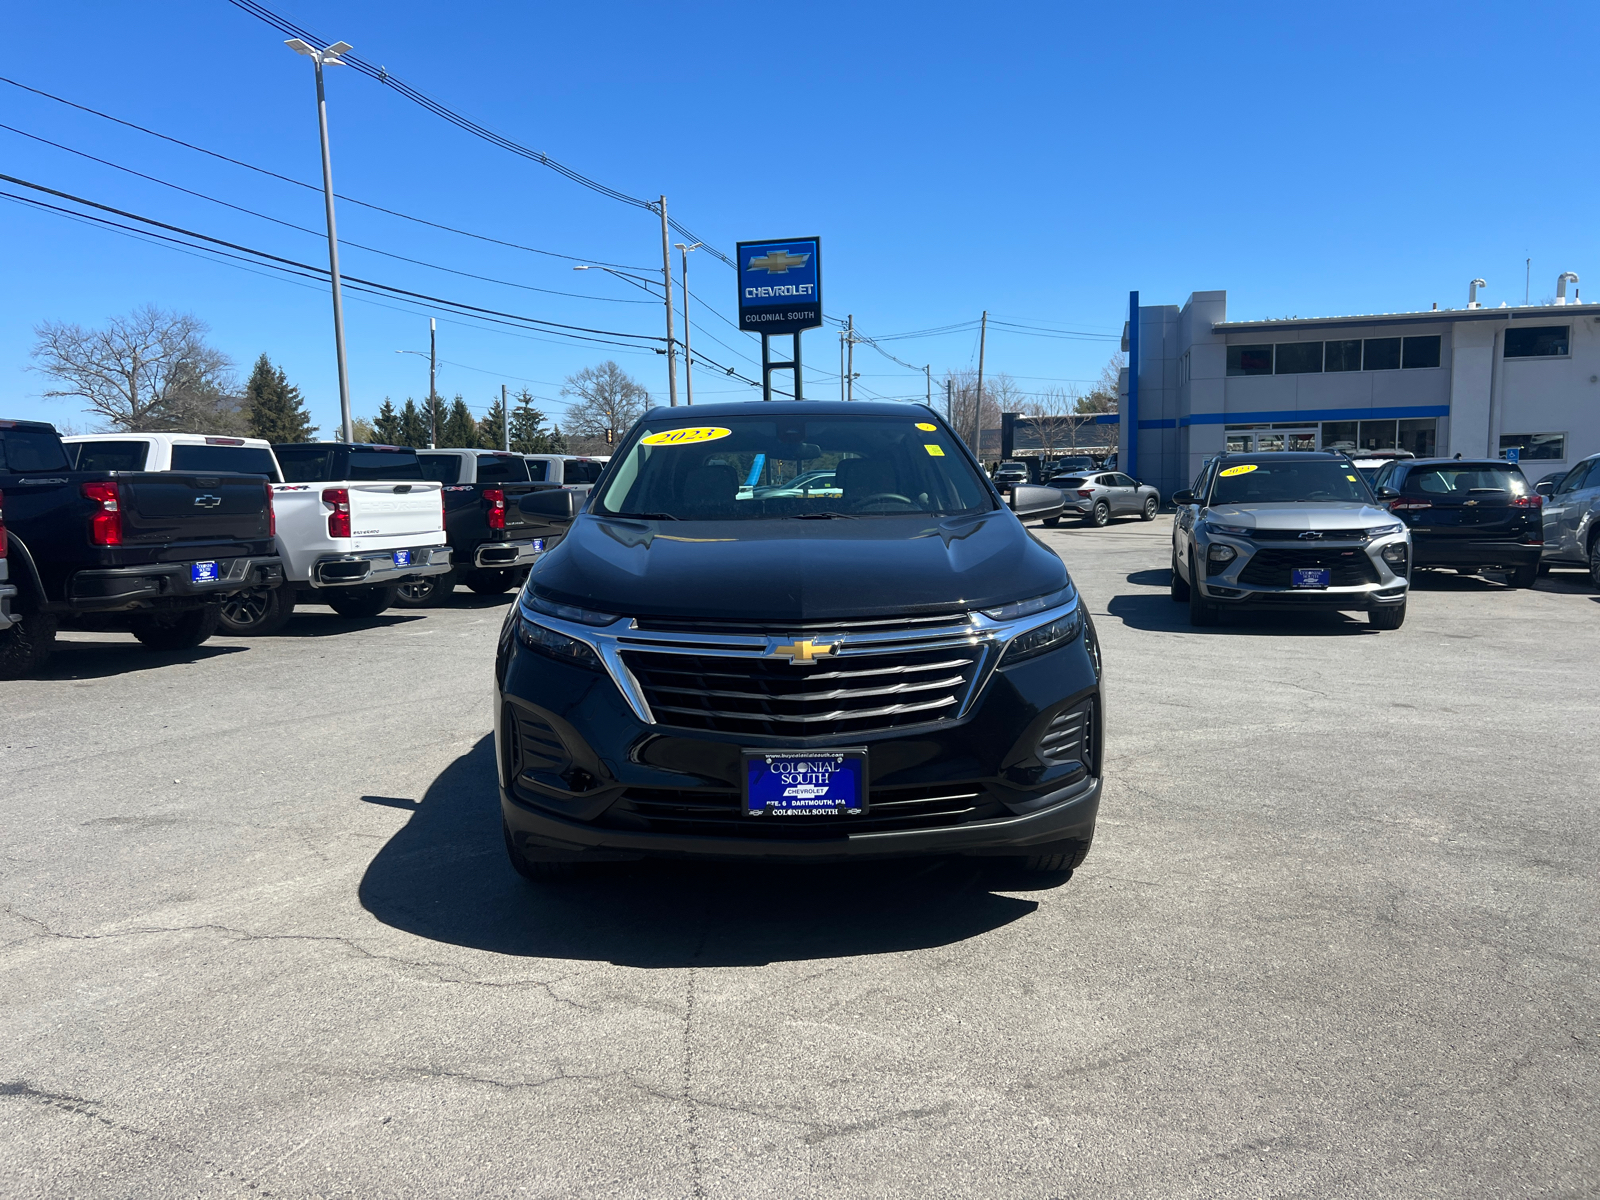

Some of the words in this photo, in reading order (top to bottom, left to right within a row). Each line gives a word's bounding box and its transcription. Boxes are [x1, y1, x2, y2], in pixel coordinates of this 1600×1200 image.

[745, 284, 814, 298] CHEVROLET
[745, 312, 785, 322] COLONIAL
[787, 311, 815, 320] SOUTH
[655, 428, 716, 443] 2023
[770, 762, 841, 773] COLONIAL
[781, 773, 830, 784] SOUTH
[791, 799, 835, 807] DARTMOUTH,
